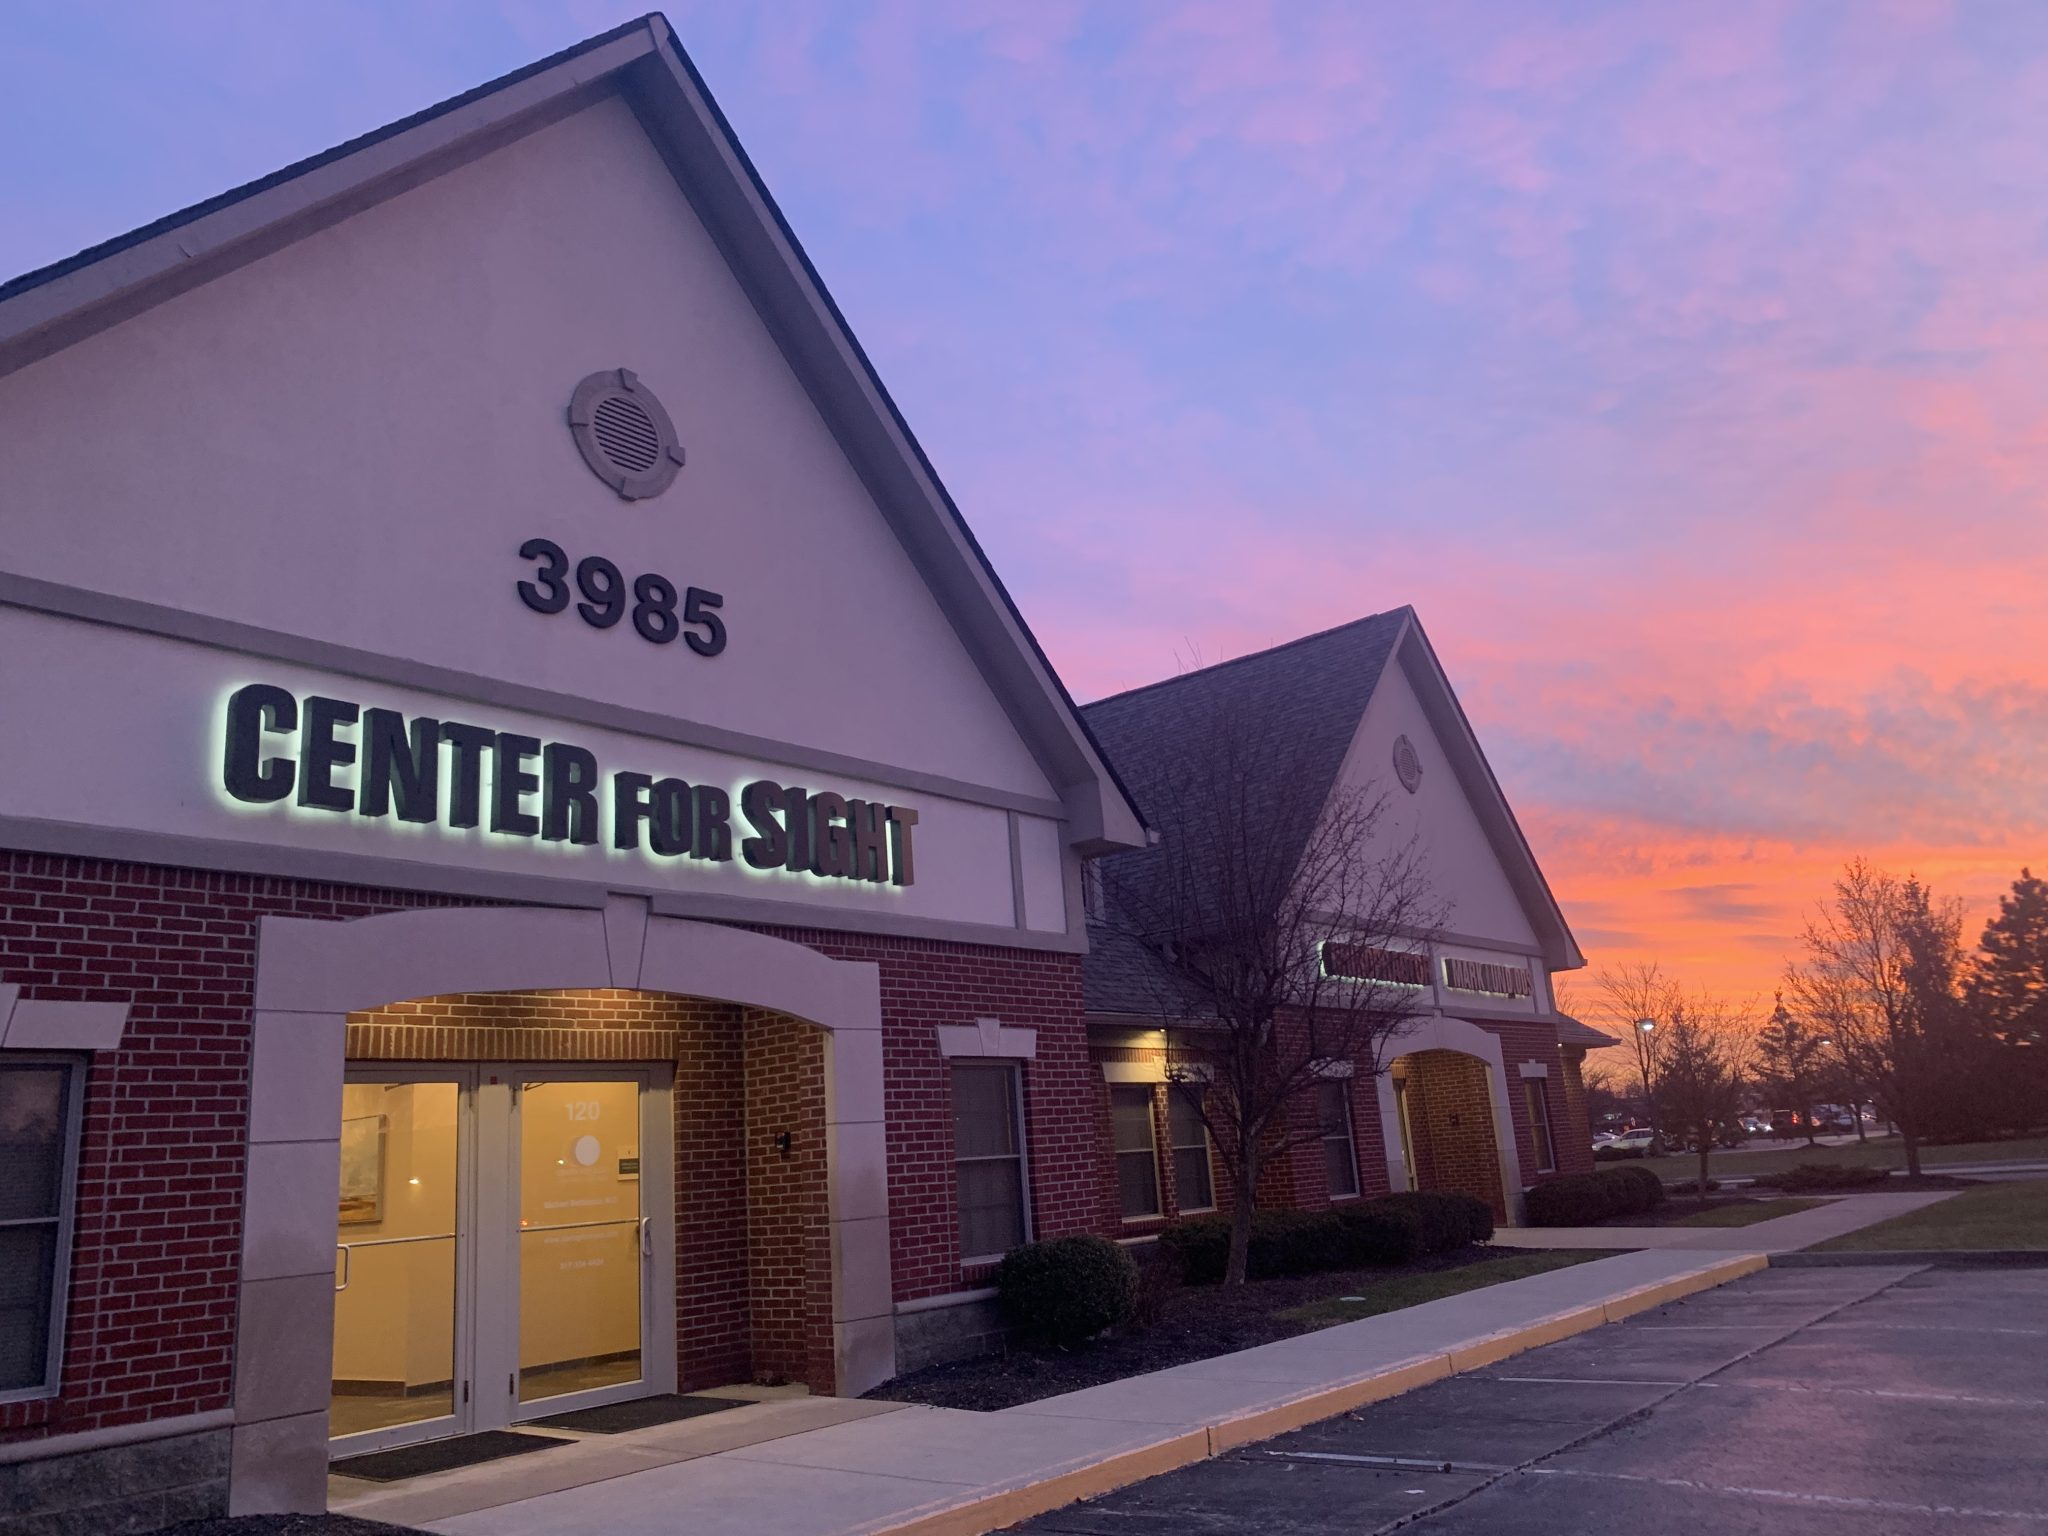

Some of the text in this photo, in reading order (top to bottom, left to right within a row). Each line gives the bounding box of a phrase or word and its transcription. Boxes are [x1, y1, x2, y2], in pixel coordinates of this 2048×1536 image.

[517, 539, 728, 656] 3985
[223, 684, 919, 887] CENTER FOR SIGHT
[1446, 959, 1486, 992] MARK
[564, 1101, 601, 1121] 120
